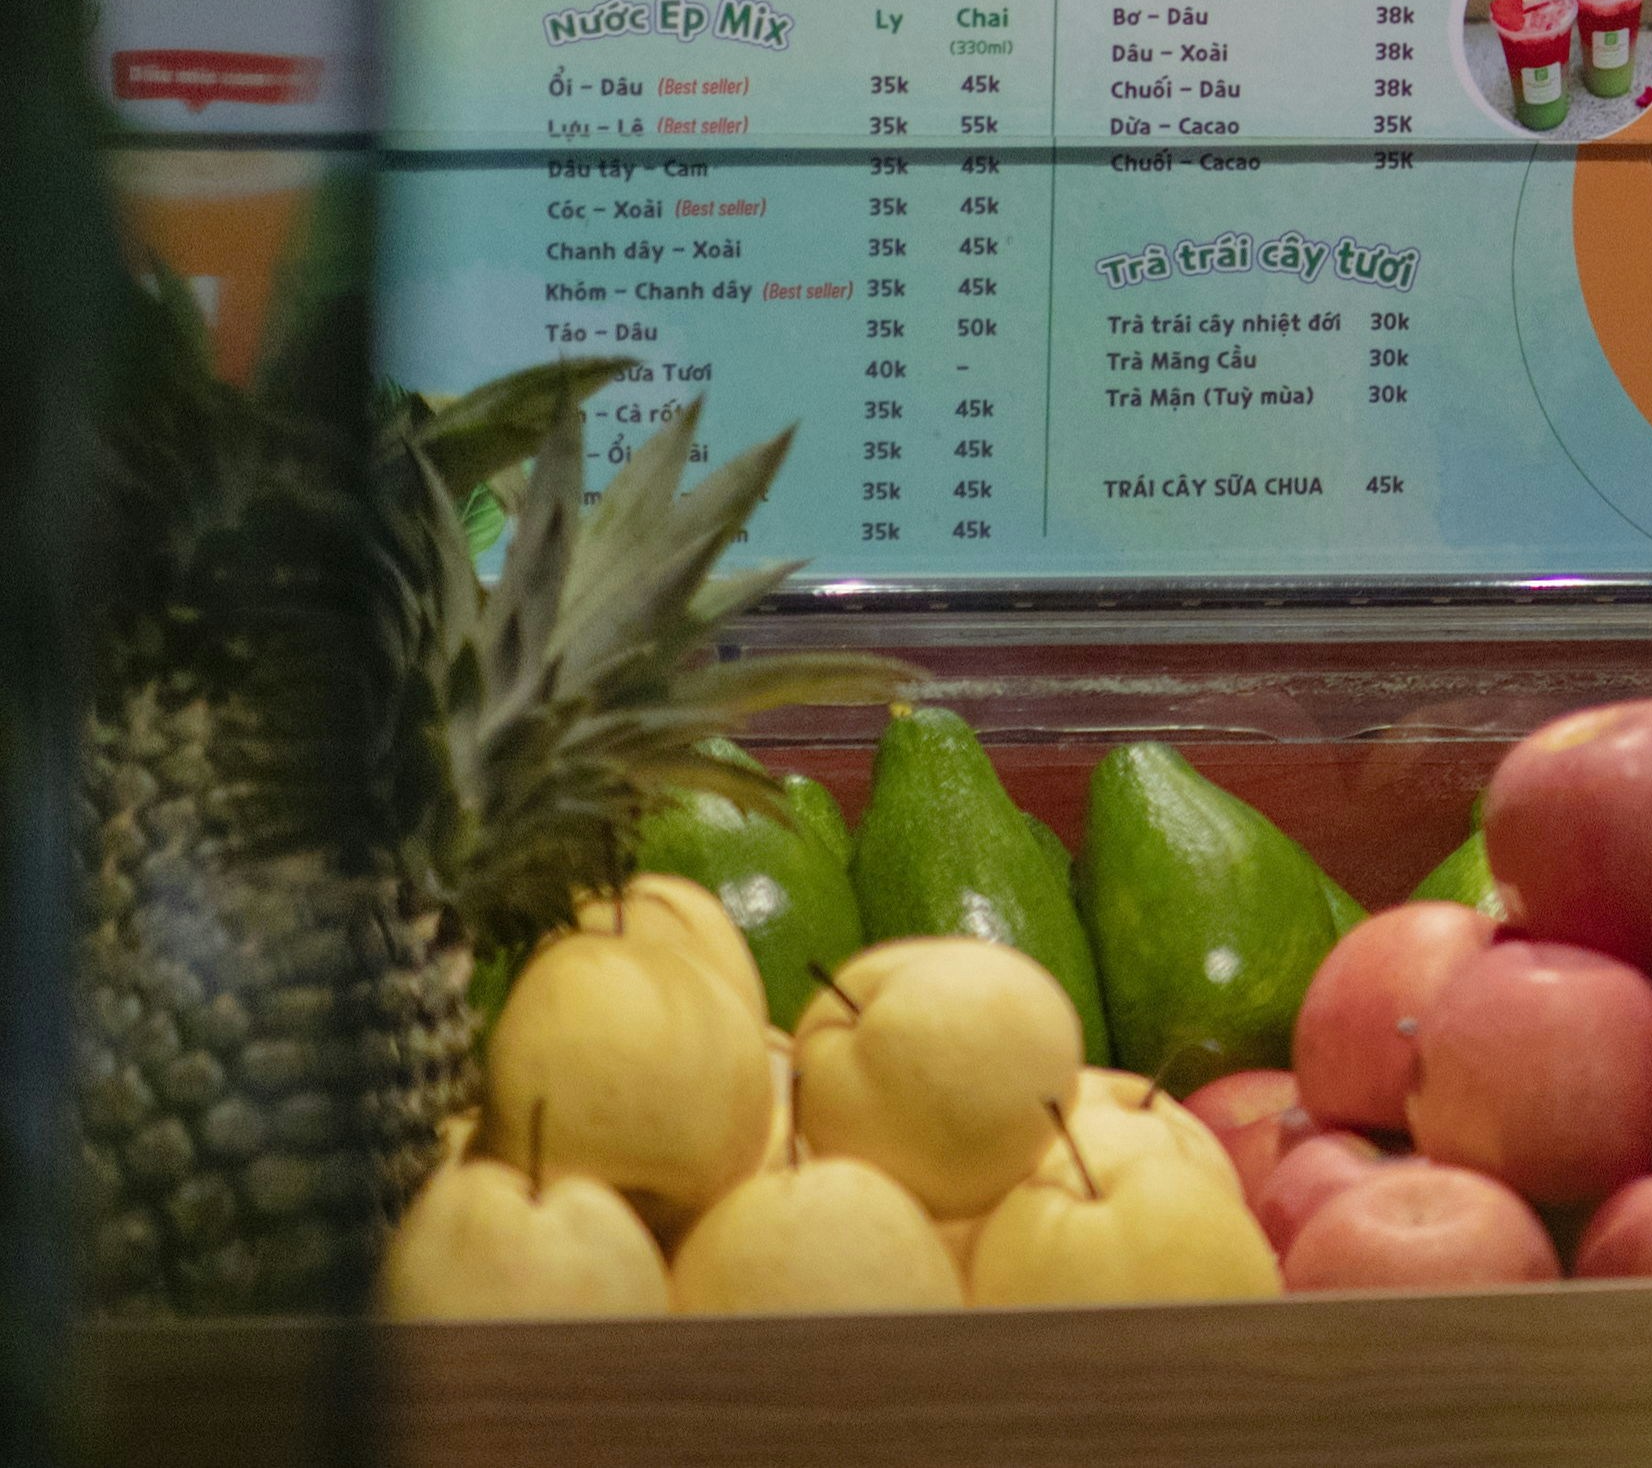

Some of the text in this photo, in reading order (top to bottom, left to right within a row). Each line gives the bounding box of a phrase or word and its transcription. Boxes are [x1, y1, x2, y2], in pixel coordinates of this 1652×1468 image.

[546, 2, 649, 47] Nước
[716, 4, 790, 50] Mix
[1099, 234, 1417, 291] Trà trái cây tươi
[1107, 312, 1409, 337] Trà trái cây nhiệt đới 30k
[1106, 344, 1408, 374] Trà Mãng Cầu 30k
[1104, 473, 1404, 498] TRÁI CÂY SỮA CHUA 45k
